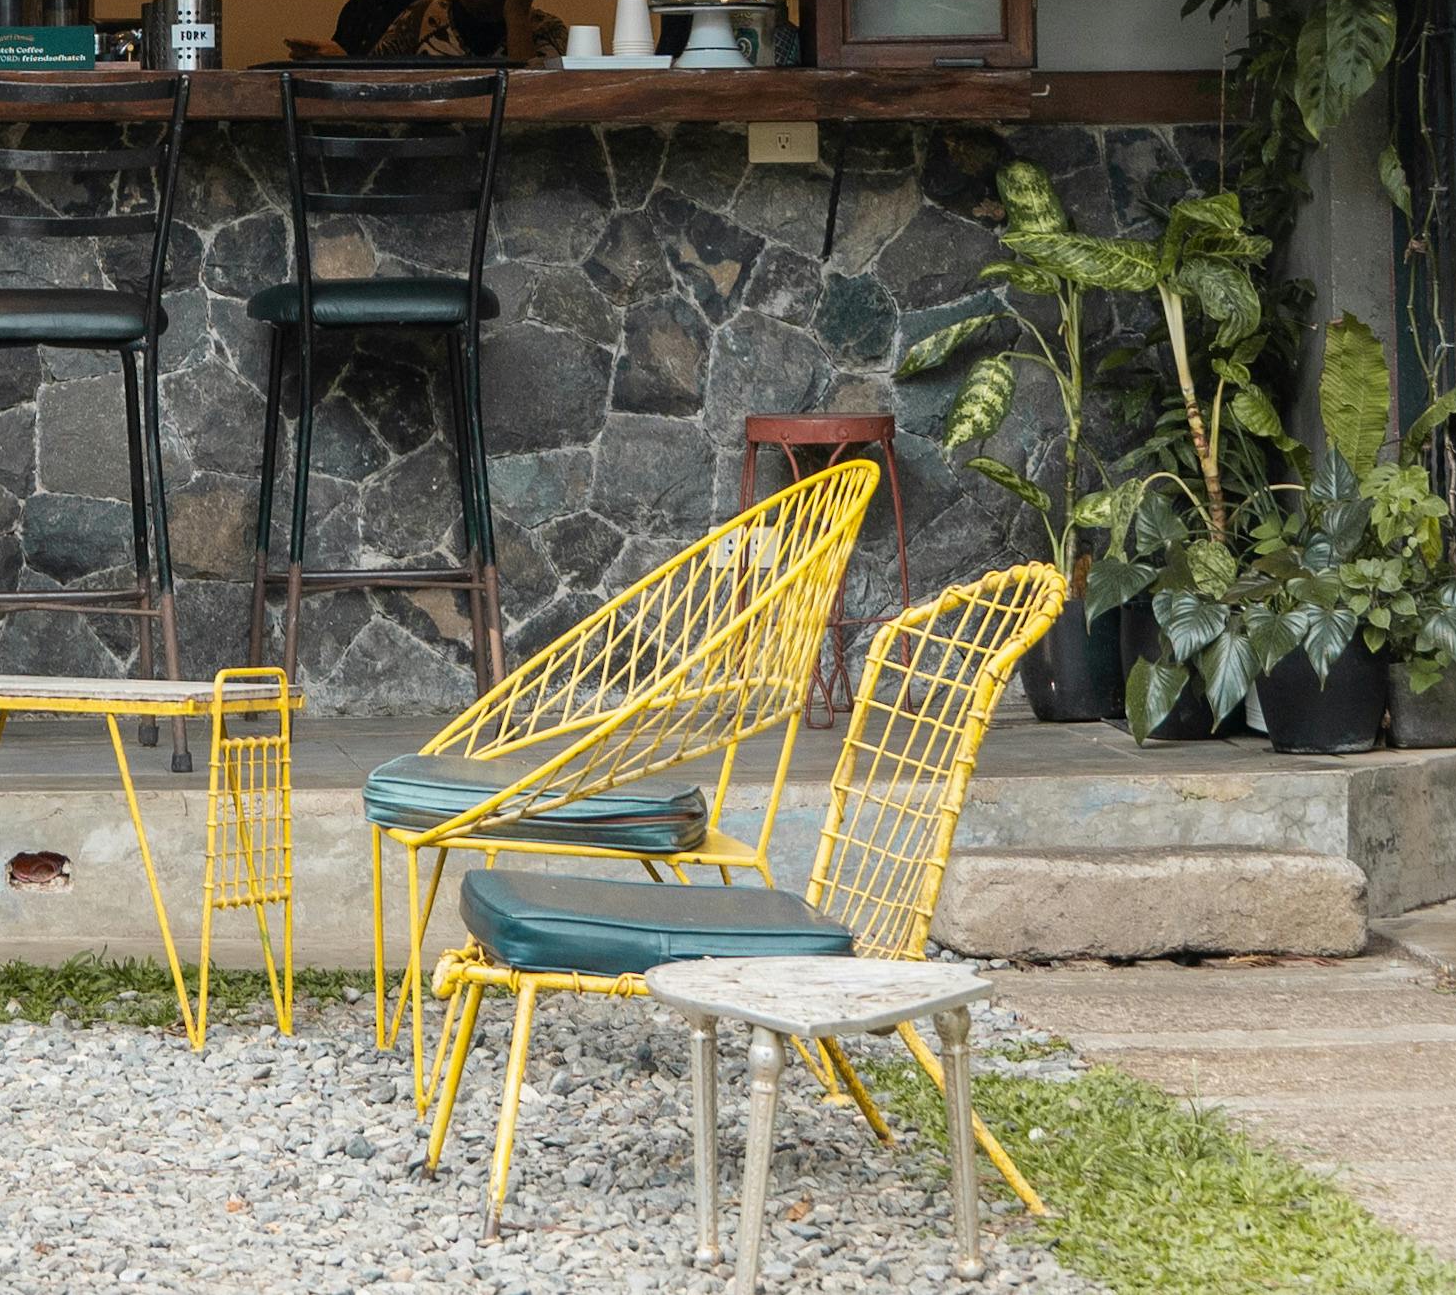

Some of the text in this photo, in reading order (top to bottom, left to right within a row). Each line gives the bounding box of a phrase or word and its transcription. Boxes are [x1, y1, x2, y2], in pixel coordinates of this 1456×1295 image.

[180, 31, 207, 41] FORK
[16, 46, 44, 54] Coffee
[22, 54, 86, 63] friendsofhatch
